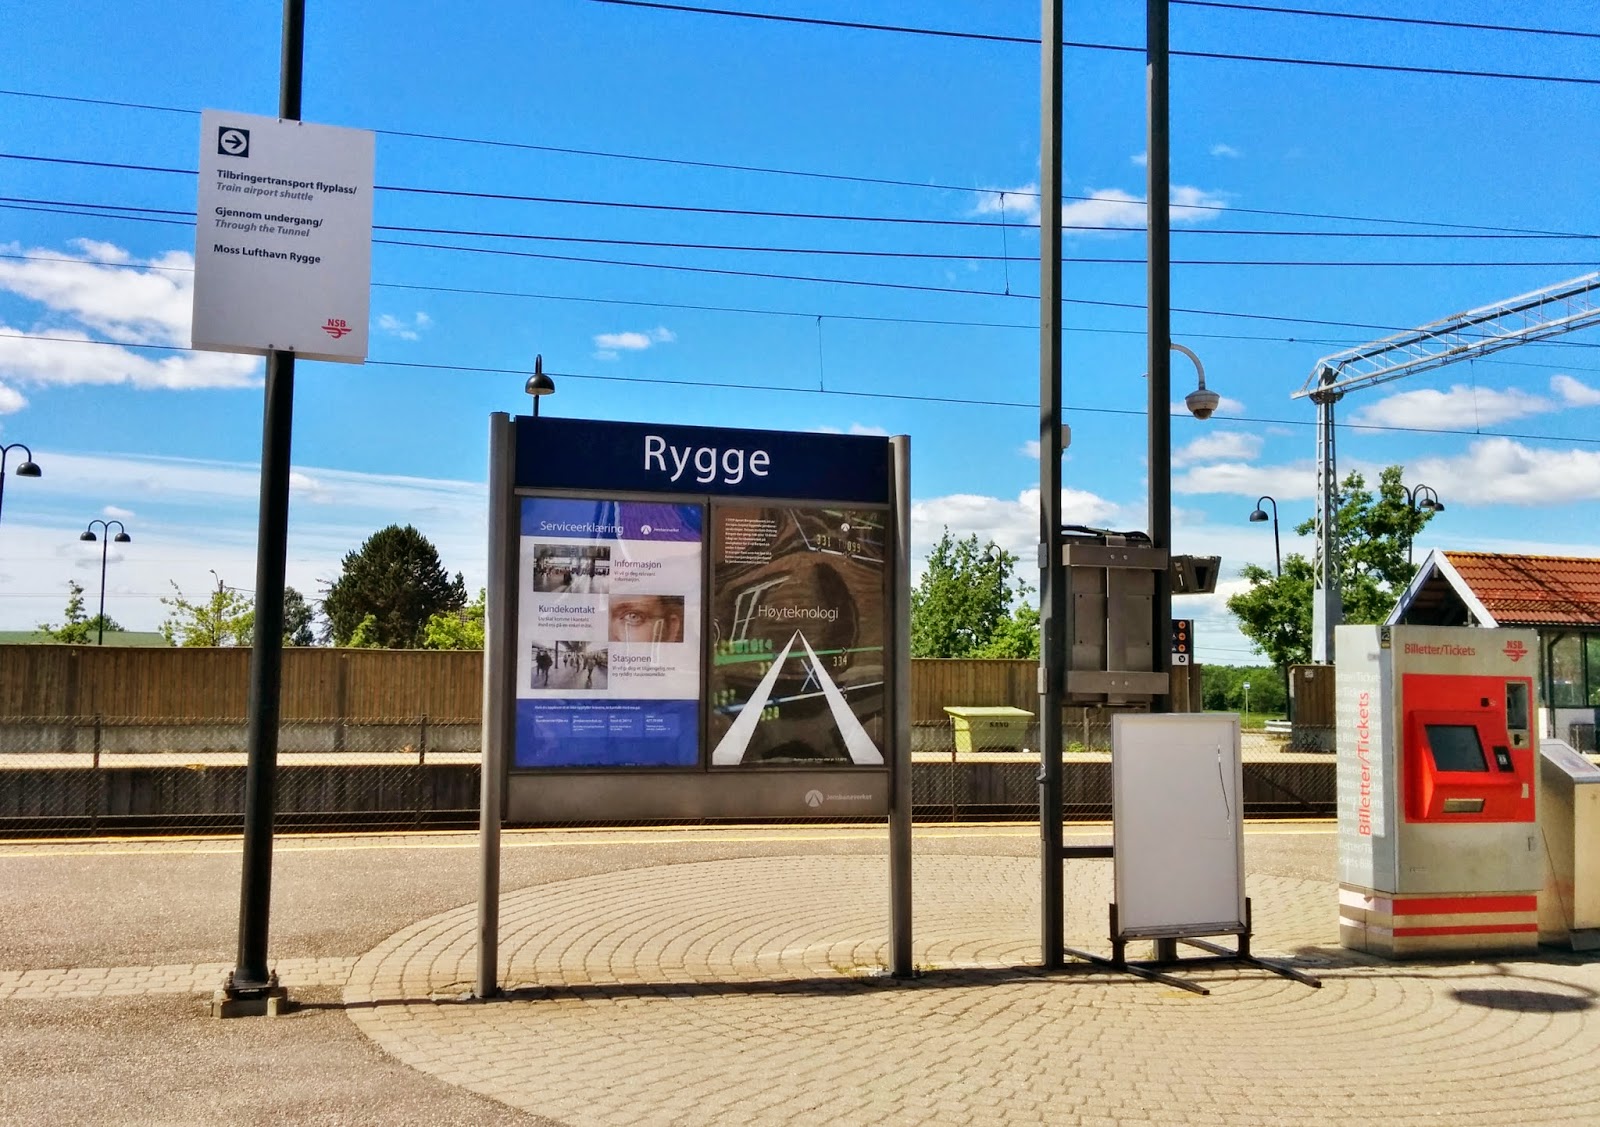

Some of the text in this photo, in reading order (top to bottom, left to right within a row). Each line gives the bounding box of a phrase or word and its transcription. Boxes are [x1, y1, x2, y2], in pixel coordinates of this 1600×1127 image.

[217, 169, 357, 195] Tilbringertransport flyplass/
[217, 182, 314, 201] Train airport shuttle
[215, 206, 324, 228] Gjennom undergang/
[215, 219, 310, 237] Through the Tunnel
[213, 244, 321, 265] Moss Lufthavn Rygge
[327, 318, 346, 328] NSB
[644, 435, 771, 485] Rygge
[540, 520, 624, 536] Serviceerklæring
[614, 559, 662, 570] Informasjon
[538, 604, 595, 614] Kundekontakt
[758, 604, 839, 622] Høyteknologi
[1404, 643, 1476, 656] Billetter/Tickets
[1506, 640, 1523, 649] NSB
[612, 653, 652, 664] Stasjonen
[1357, 692, 1371, 836] Billetter/Tickets
